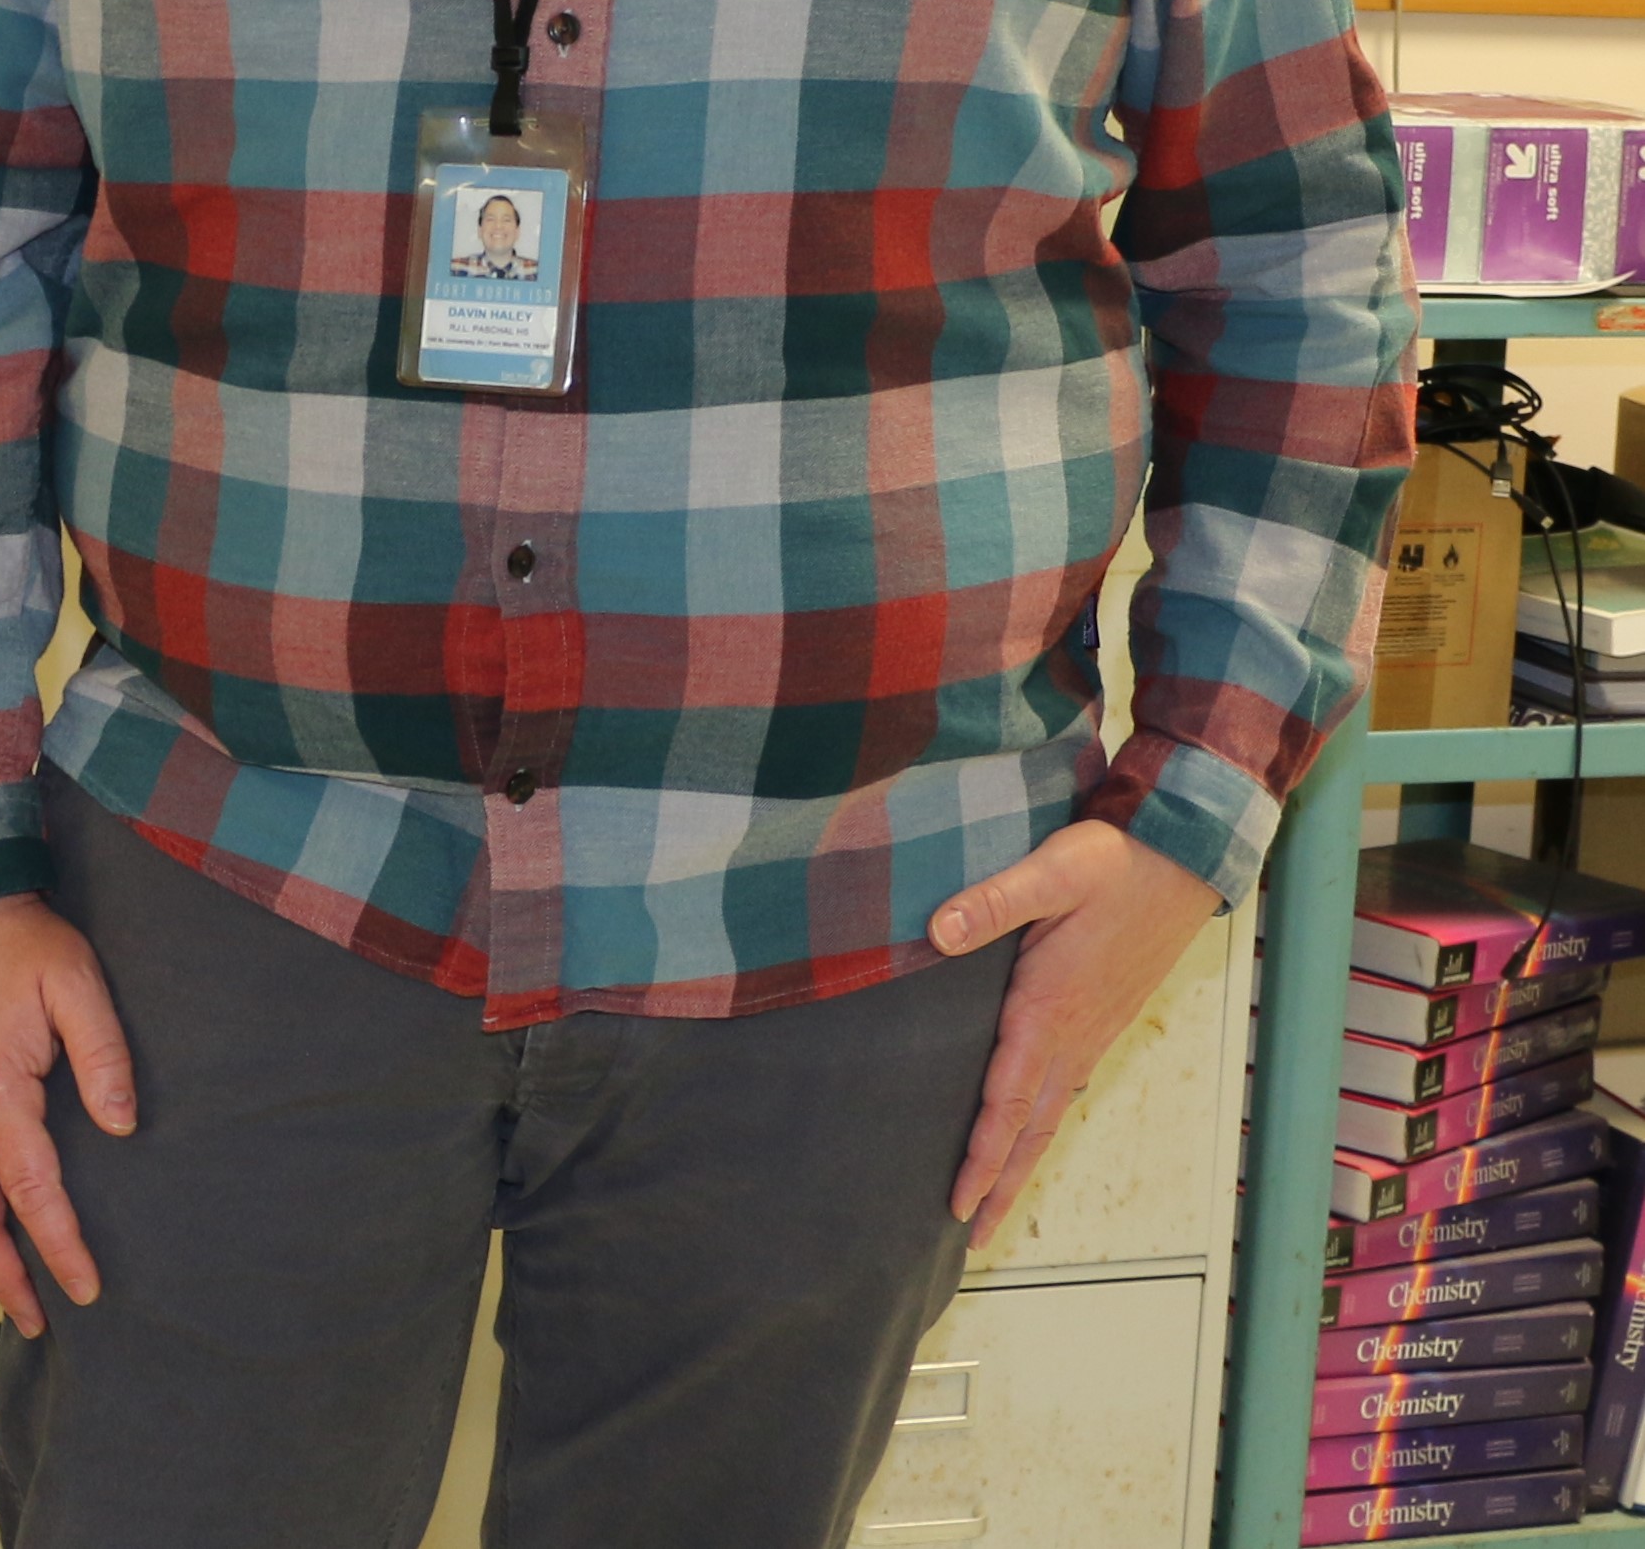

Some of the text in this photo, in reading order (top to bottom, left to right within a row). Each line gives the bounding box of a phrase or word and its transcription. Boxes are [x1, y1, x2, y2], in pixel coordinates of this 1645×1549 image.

[1410, 141, 1427, 220] ultra soft
[1546, 143, 1562, 221] ultra soft
[448, 306, 534, 323] DAVIN HALEY
[1444, 1156, 1520, 1192] Chemistry
[1398, 1215, 1489, 1248] Chemistry
[1388, 1276, 1486, 1309] Chemistry
[1356, 1333, 1464, 1362] Chemistry
[1360, 1389, 1465, 1420] Chemistry
[1351, 1439, 1456, 1472] Chemistry
[1348, 1497, 1455, 1527] Chemistry
